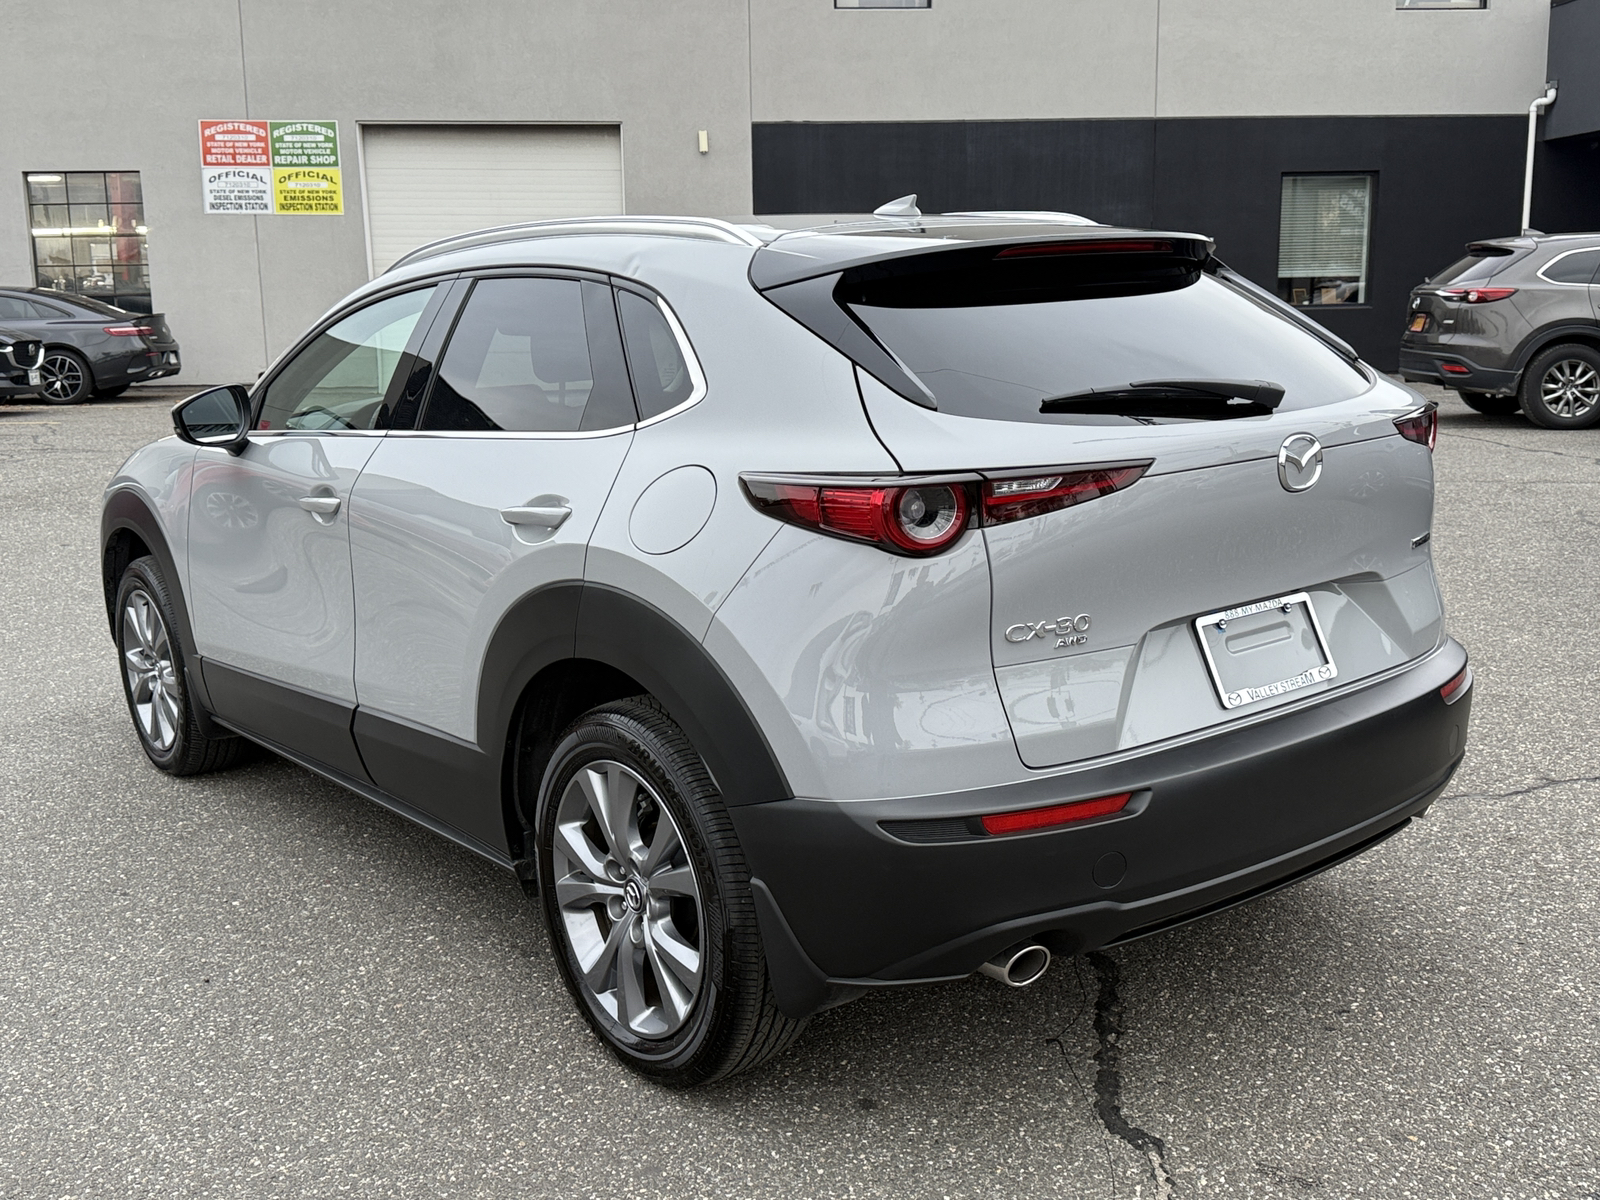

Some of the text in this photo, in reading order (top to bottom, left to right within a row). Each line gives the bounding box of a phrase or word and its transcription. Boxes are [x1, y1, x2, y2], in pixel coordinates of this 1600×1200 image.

[204, 122, 266, 137] REGISTERED
[273, 123, 334, 138] REGISTERED
[206, 154, 267, 164] RETAIL DEALER
[274, 155, 336, 164] REPAIR SHOP
[208, 170, 267, 185] OFFICIAL
[278, 170, 337, 185] OFFICIAL
[209, 202, 268, 211] INSPECTION STATION
[279, 202, 338, 211] INSPECTION STATION
[1255, 599, 1283, 611] MAZDA
[1005, 613, 1092, 643] CX-30
[1054, 634, 1088, 649] AWD
[1247, 672, 1315, 701] VALLEY STREAM
